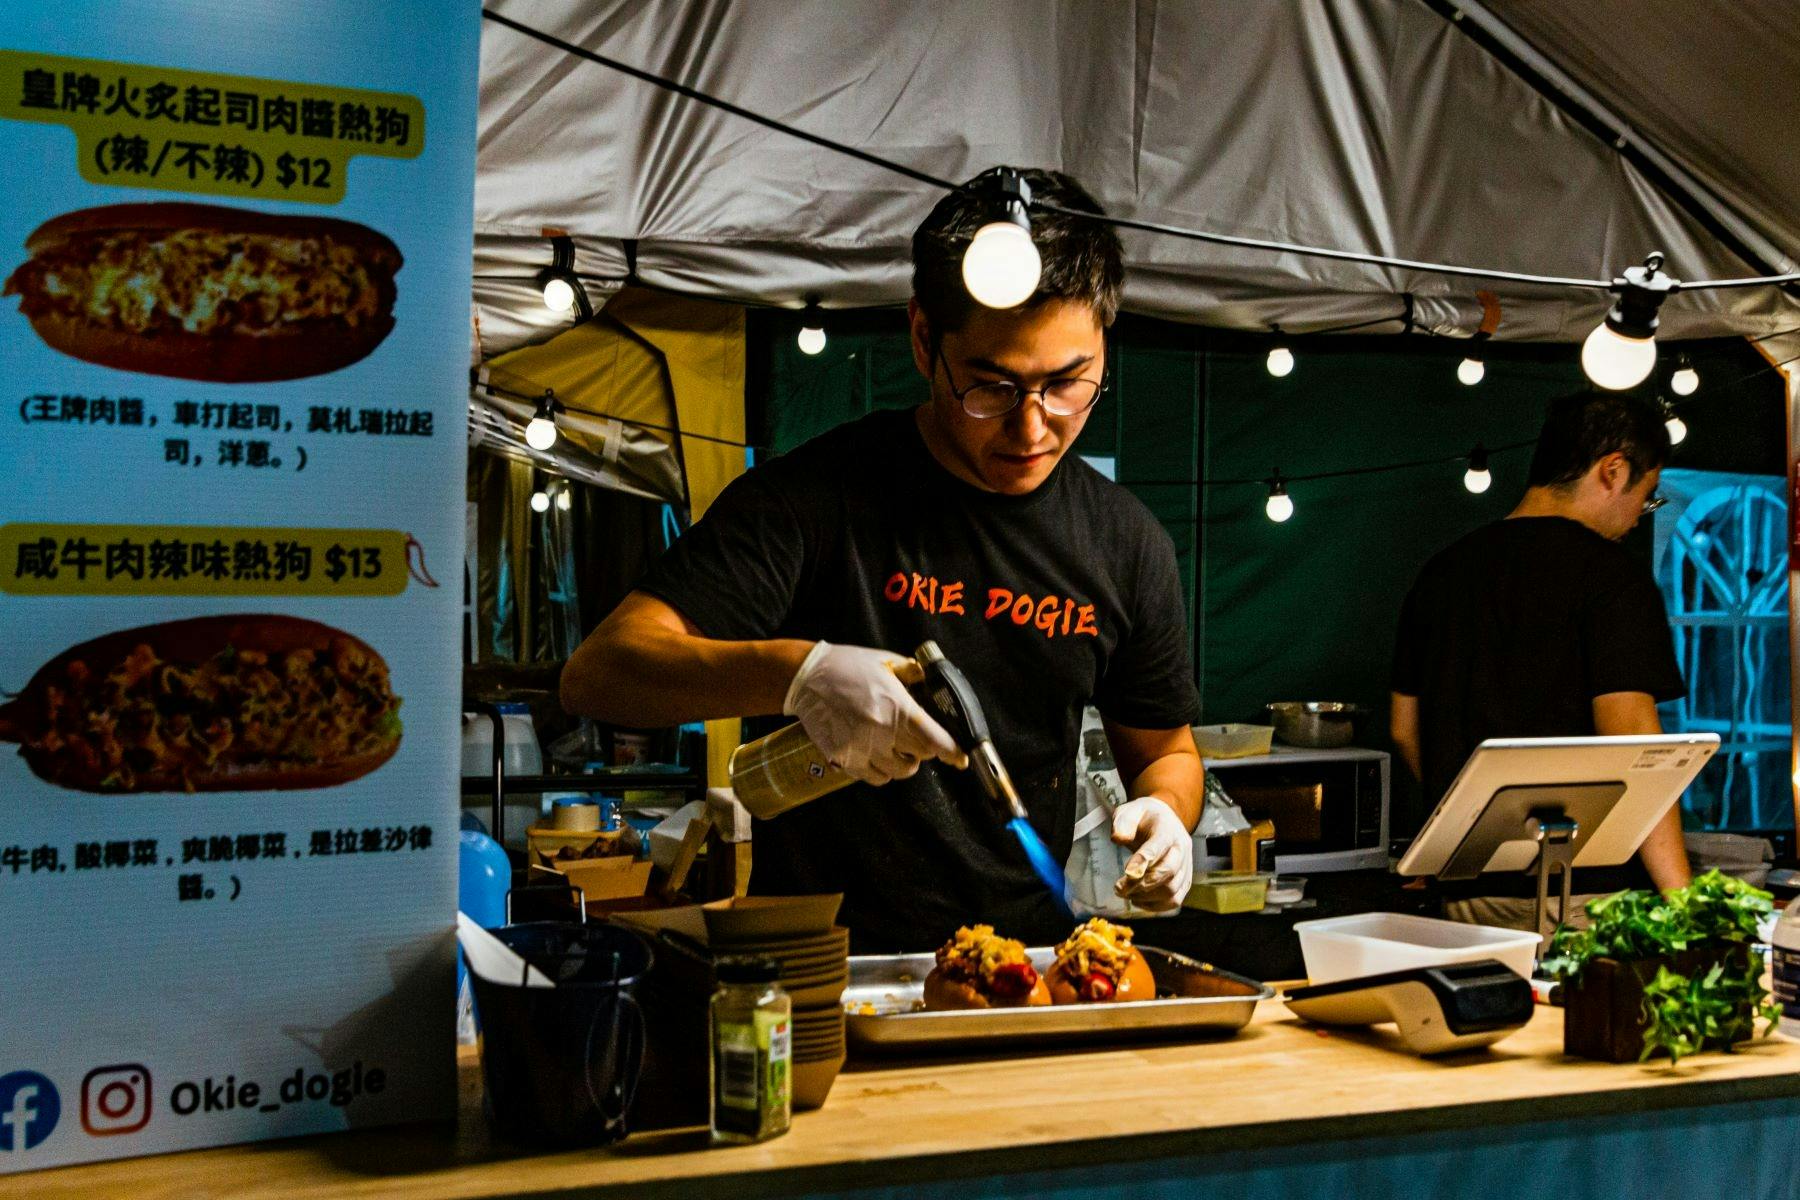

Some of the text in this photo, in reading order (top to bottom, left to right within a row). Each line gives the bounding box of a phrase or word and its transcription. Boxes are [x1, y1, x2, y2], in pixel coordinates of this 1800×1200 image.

[20, 68, 410, 146] 皇牌火炙起司肉醬熱狗
[276, 152, 332, 188] $12
[15, 538, 382, 582] 咸牛肉辣味熱狗 $13
[884, 572, 1098, 638] OKIE DOGIE
[171, 1061, 387, 1115] Okie_dogie
